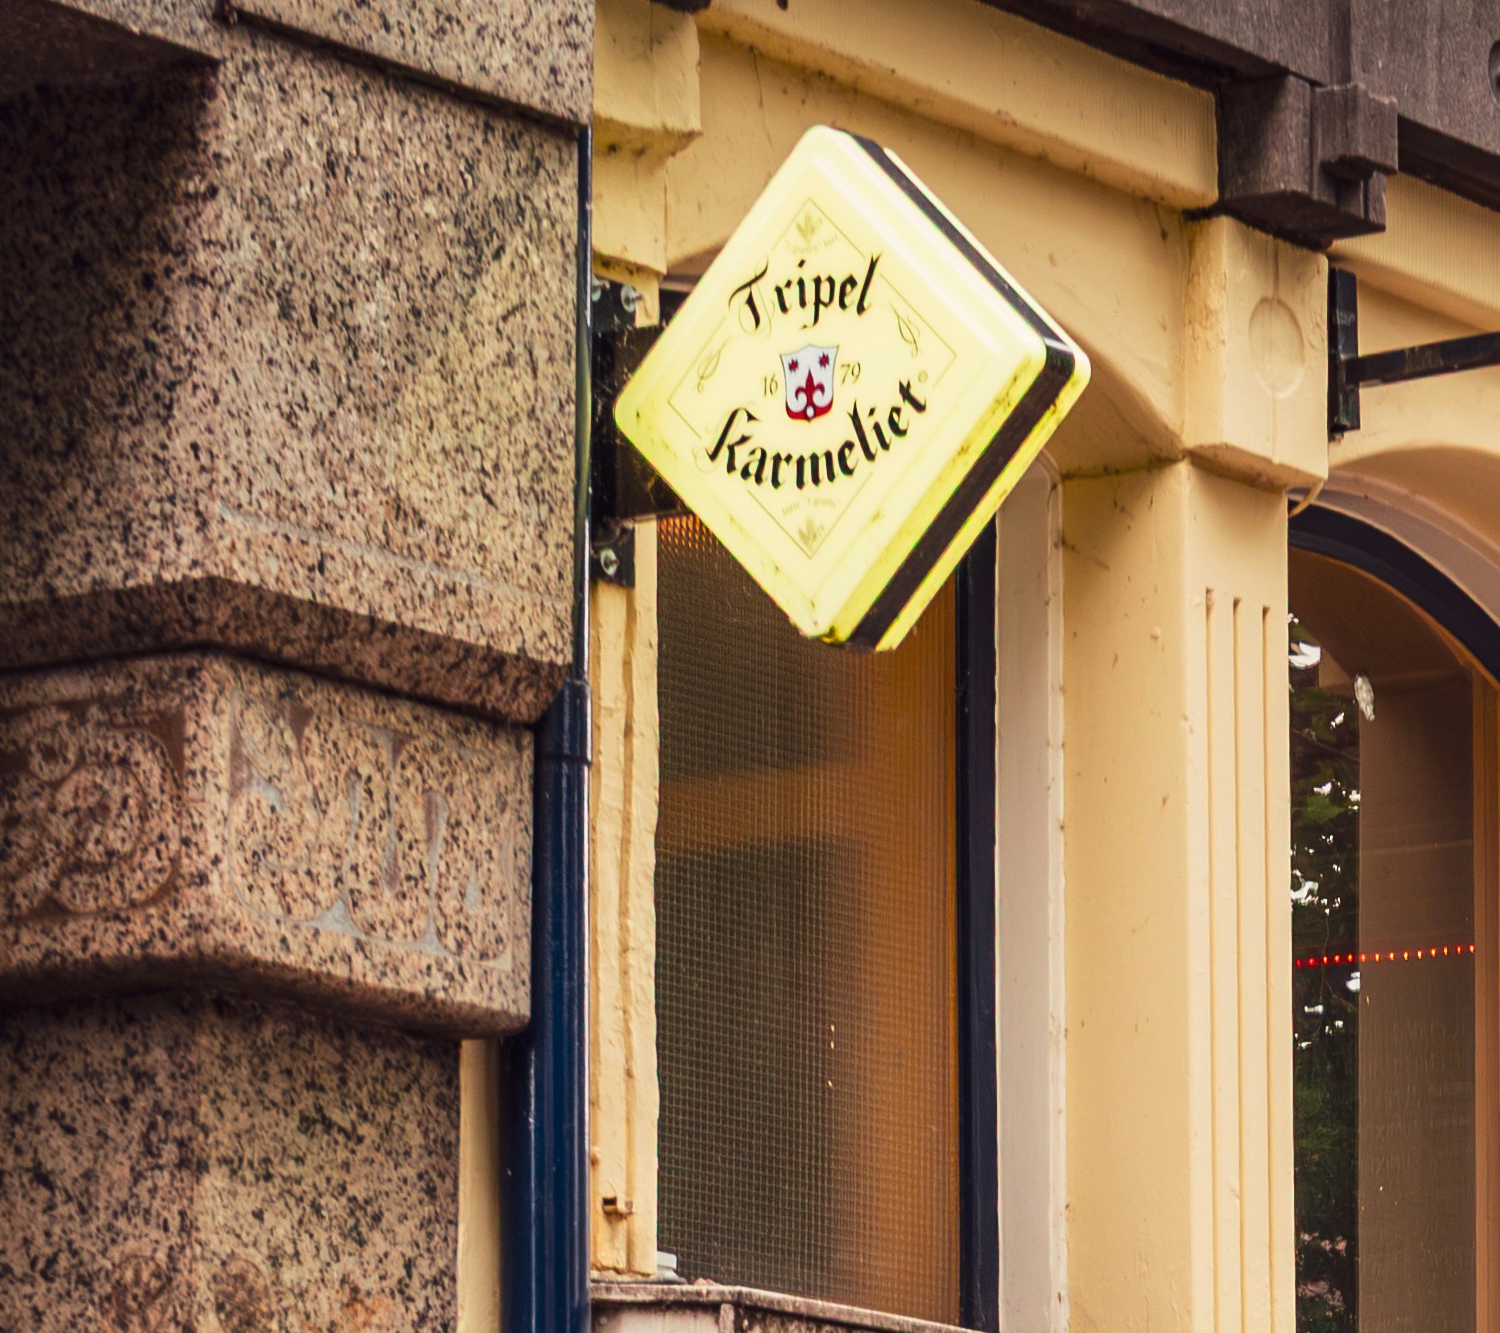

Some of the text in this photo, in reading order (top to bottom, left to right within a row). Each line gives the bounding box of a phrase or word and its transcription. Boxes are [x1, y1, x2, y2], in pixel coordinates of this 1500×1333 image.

[729, 252, 882, 331] Tripel
[762, 362, 861, 395] 16 79
[706, 376, 927, 490] Karmeliet
